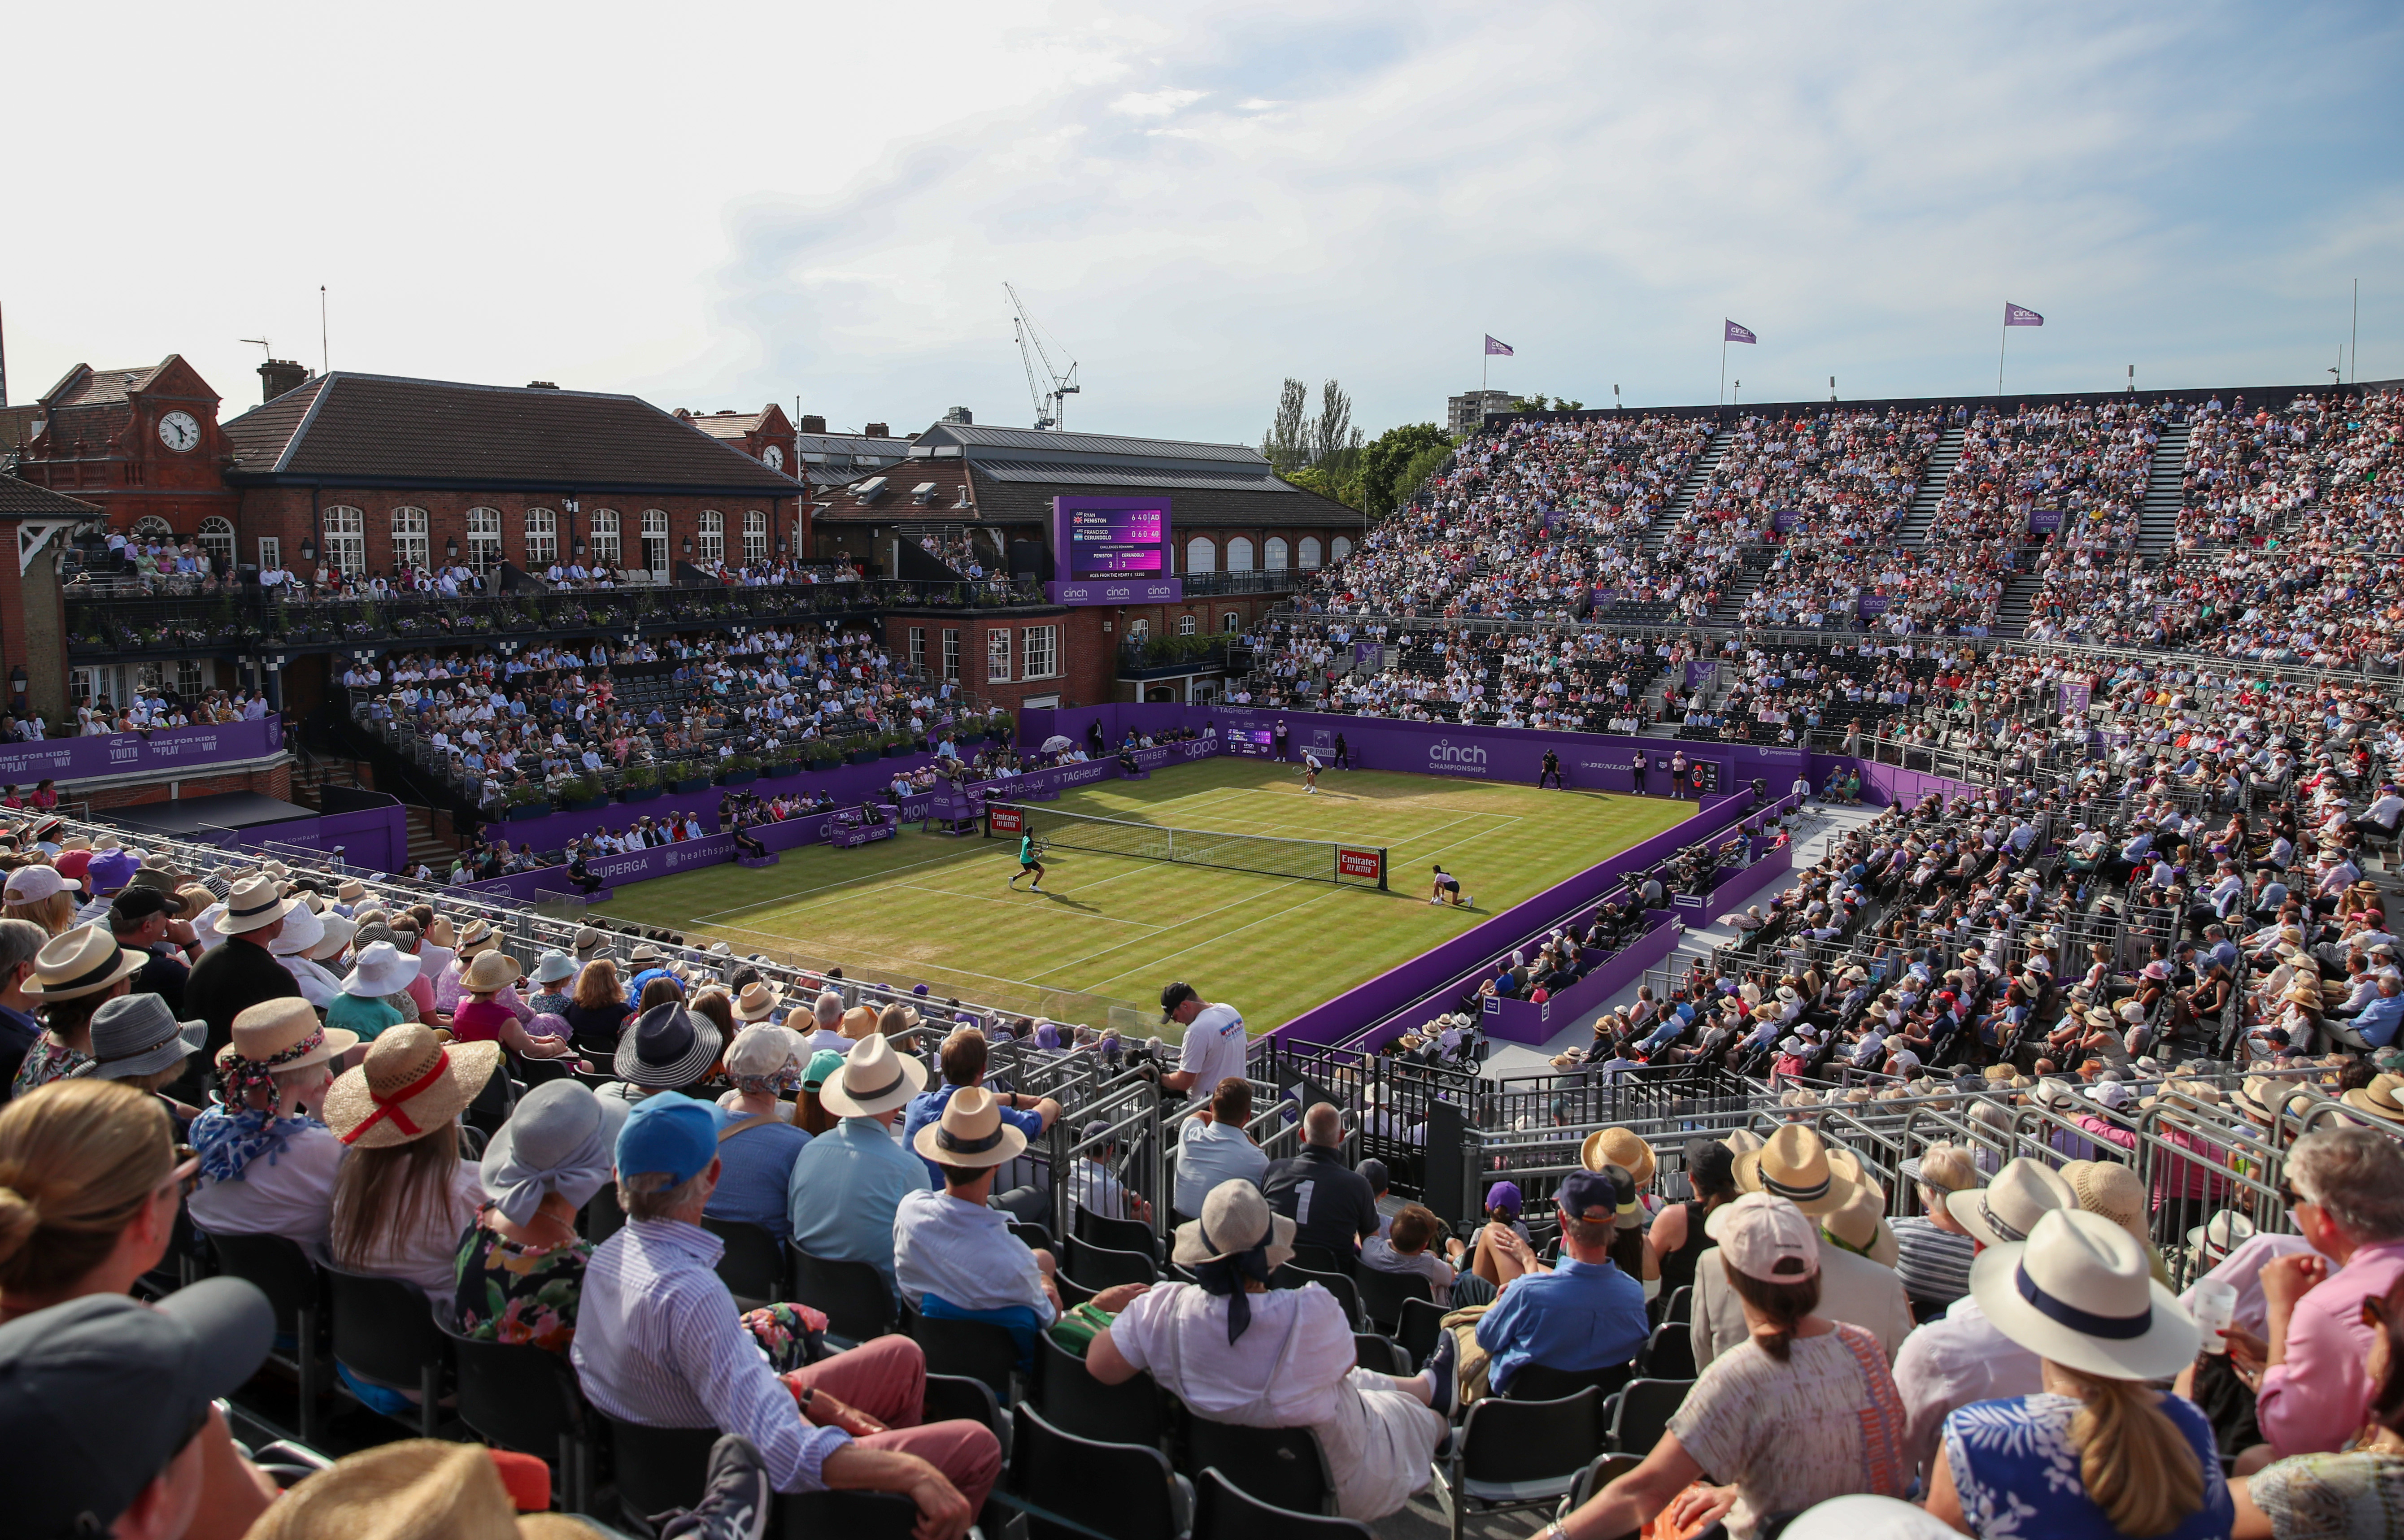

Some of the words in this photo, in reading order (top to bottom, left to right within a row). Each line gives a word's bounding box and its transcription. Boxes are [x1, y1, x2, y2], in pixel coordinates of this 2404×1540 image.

[1064, 587, 1087, 597] cinch
[1106, 586, 1129, 596] cinch
[1148, 585, 1170, 595] cinch
[1864, 598, 1887, 607] cinch
[110, 747, 138, 760] YOUTH
[161, 745, 179, 756] PLAY
[202, 741, 217, 751] WAY
[1430, 739, 1486, 764] cinch
[1135, 750, 1167, 763] ETIMBER
[7, 761, 27, 772] PLAY
[54, 756, 71, 767] WAY
[1429, 763, 1486, 773] CHAMPIONSHIPS
[1589, 762, 1633, 771] DUNLOP
[967, 790, 979, 798] inch
[934, 796, 949, 804] cinch
[993, 812, 1019, 822] Emirates
[287, 834, 319, 843] COMPANY
[850, 834, 865, 842] cinch
[871, 829, 886, 838] cinch
[681, 844, 735, 861] healthspan
[1342, 854, 1376, 866] Emirates
[592, 859, 648, 879] SUPERGA
[1355, 865, 1371, 873] BETTER
[1294, 1180, 1314, 1224] 1
